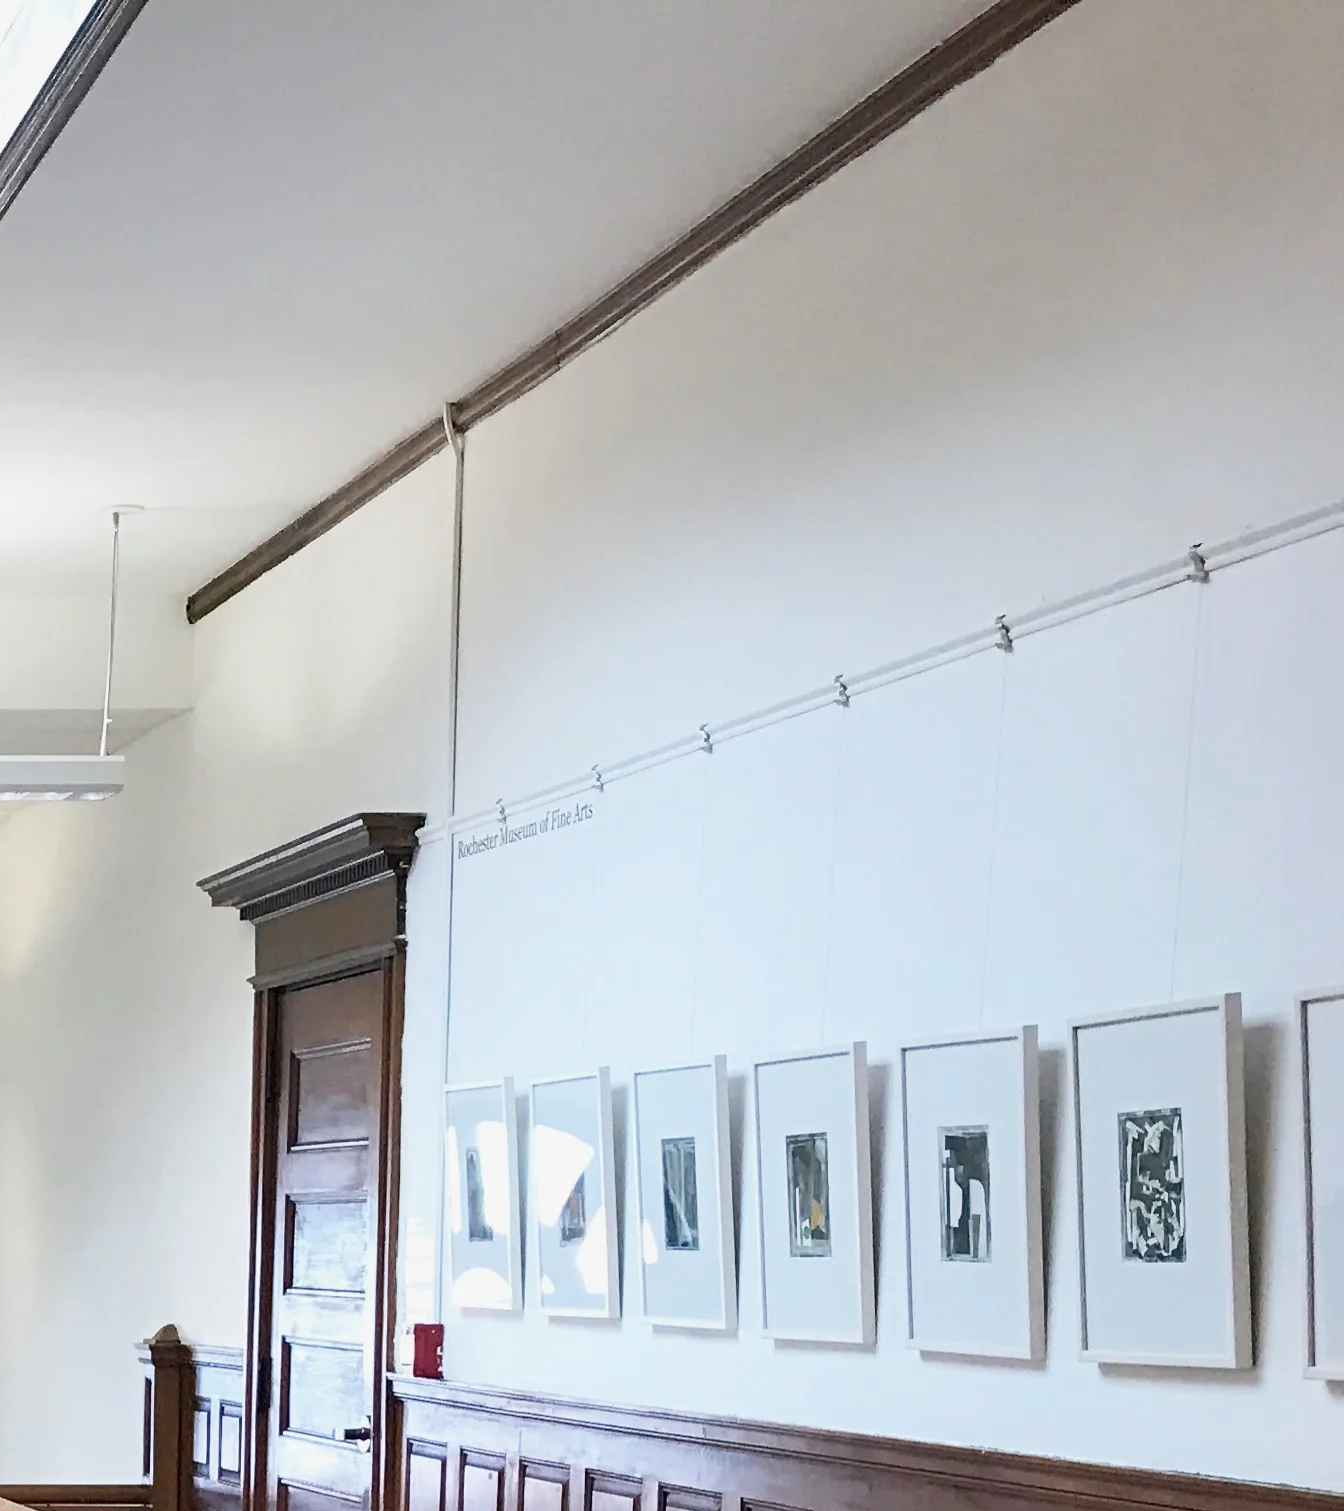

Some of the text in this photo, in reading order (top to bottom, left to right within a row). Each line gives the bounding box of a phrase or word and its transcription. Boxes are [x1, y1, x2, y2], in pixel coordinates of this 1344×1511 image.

[457, 802, 594, 860] Rochester Museum of Fine Arts
